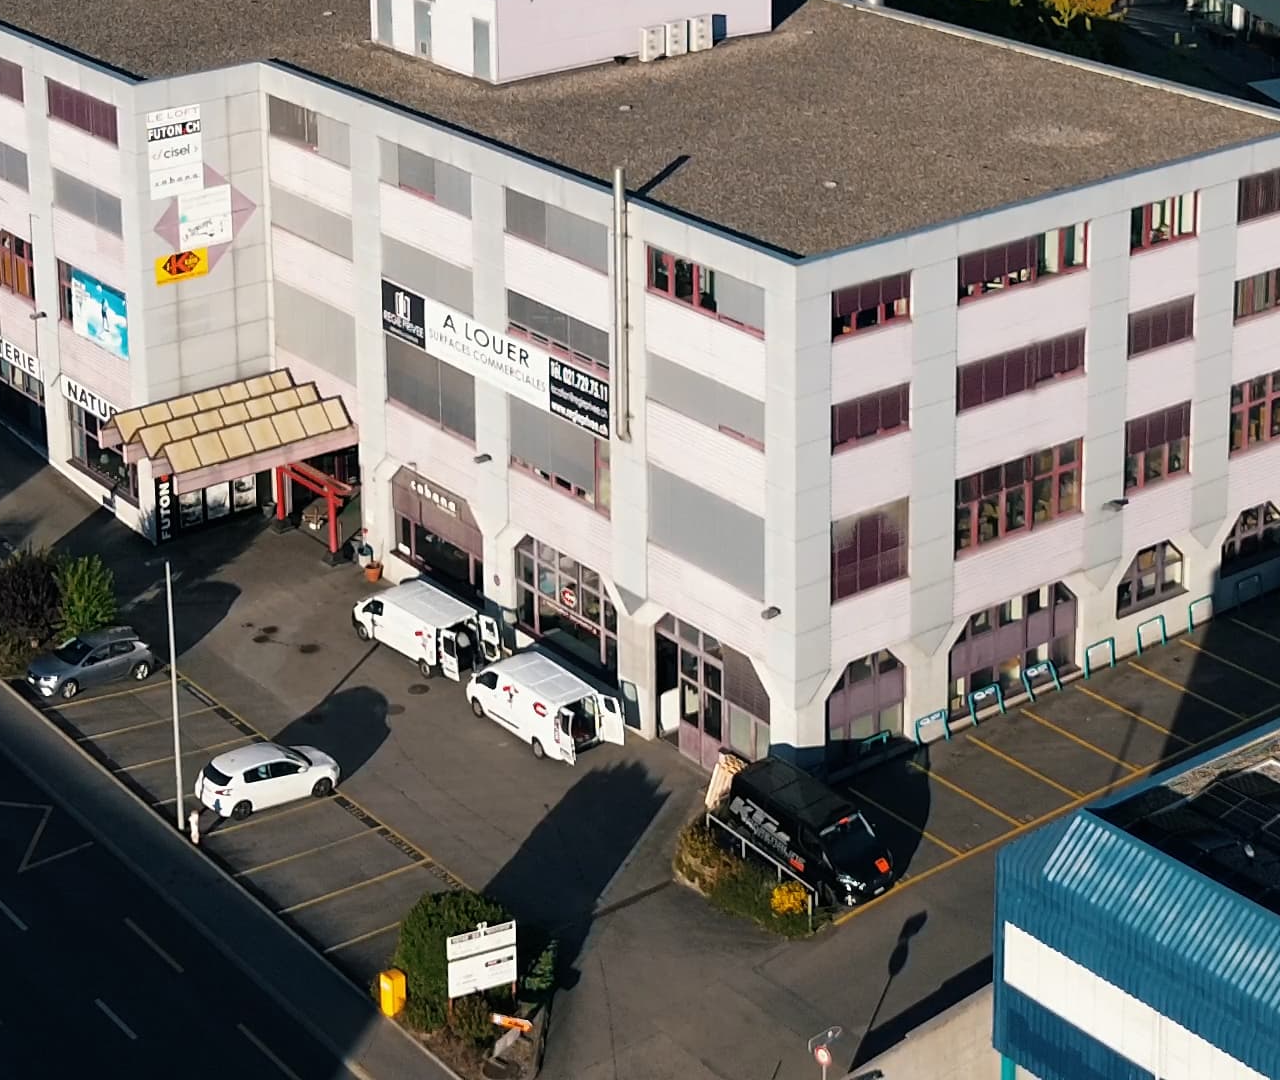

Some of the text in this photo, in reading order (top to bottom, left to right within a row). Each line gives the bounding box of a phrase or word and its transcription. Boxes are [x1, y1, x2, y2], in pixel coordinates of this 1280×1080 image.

[147, 120, 201, 142] FUTON.CH
[427, 326, 472, 358] SURFACES
[472, 350, 547, 394] COMMERCIALES
[442, 313, 457, 335] A
[464, 321, 531, 369] LOUER
[409, 477, 457, 513] cabana
